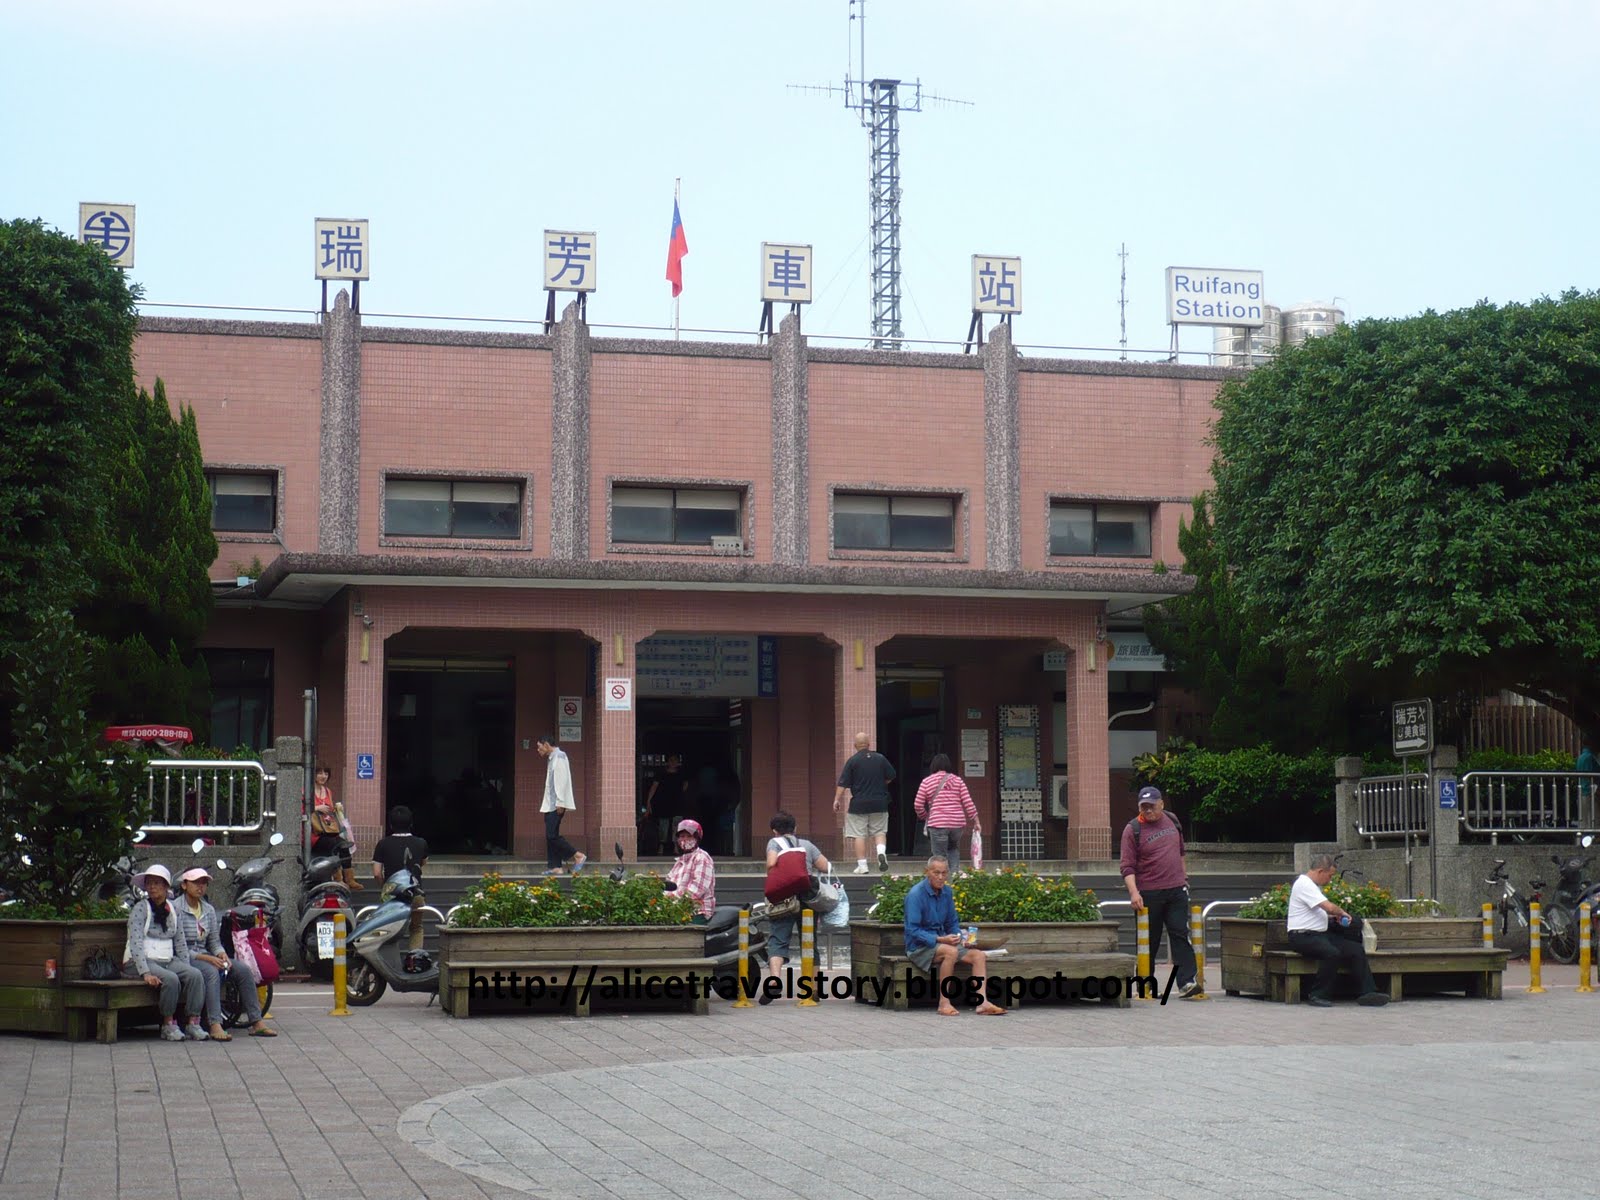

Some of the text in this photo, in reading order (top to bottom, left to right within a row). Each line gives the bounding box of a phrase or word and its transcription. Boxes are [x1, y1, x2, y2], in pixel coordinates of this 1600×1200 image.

[320, 225, 1017, 308] 瑞 芳 車 站
[1175, 275, 1260, 300] Ruifang
[1176, 298, 1261, 319] Station
[1395, 706, 1418, 726] 瑞芳
